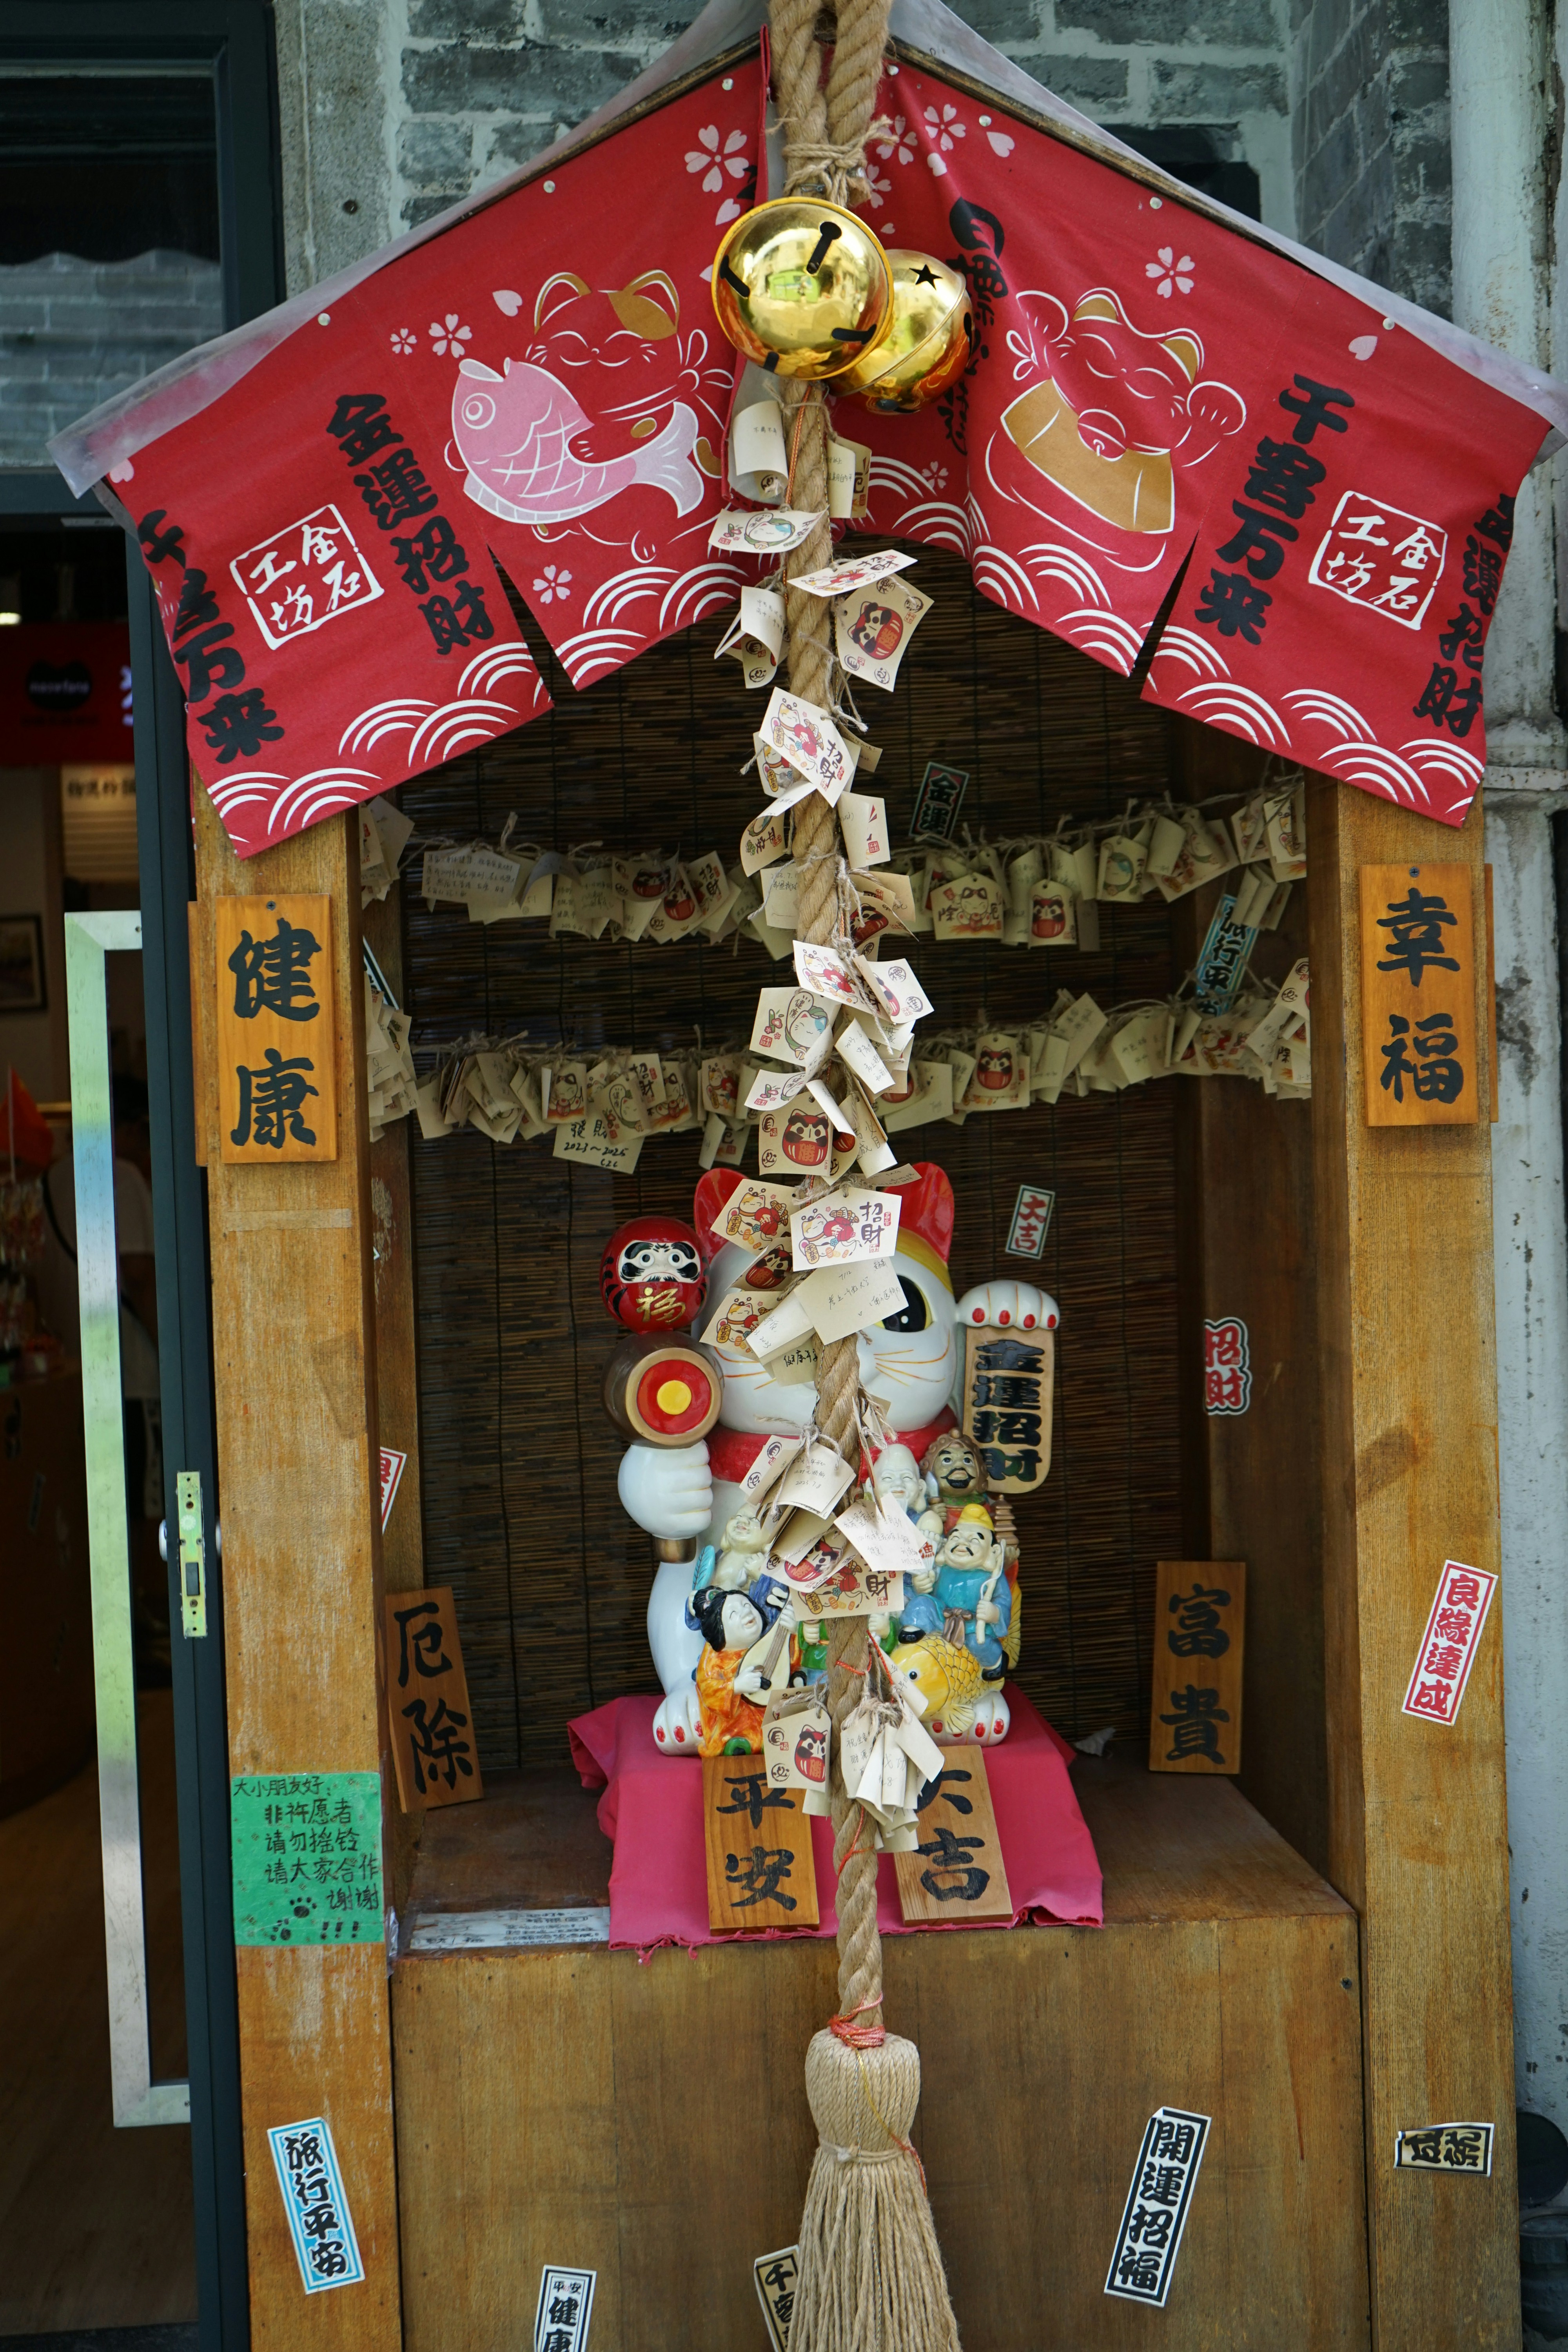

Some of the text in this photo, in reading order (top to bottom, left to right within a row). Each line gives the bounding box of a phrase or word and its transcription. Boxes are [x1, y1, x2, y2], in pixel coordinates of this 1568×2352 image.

[325, 393, 495, 655] 金運招財
[1194, 374, 1355, 645] 千客万来
[820, 739, 843, 789] 招財
[918, 772, 959, 835] 金運
[699, 863, 721, 895] 招財
[789, 999, 805, 1018] 健康
[1376, 887, 1464, 1104] 幸福
[228, 917, 322, 1149] 健康
[630, 1062, 655, 1098] 招財
[860, 1201, 884, 1248] 招財
[1015, 1195, 1047, 1250] 大吉
[636, 1287, 686, 1324] 福
[1205, 1325, 1244, 1406] 招財
[972, 1339, 1045, 1482] 金運招財
[394, 1601, 472, 1795] 厄除
[1160, 1583, 1231, 1765] 富貴
[265, 1827, 359, 1854] 请勿摇铃
[265, 1855, 379, 1884] 请大家合作
[716, 1771, 797, 1912] 平安
[327, 1884, 379, 1911] 谢谢
[285, 2132, 347, 2278] 旅行平安
[1118, 2119, 1196, 2292] 開運招福
[553, 2280, 583, 2295] 平安
